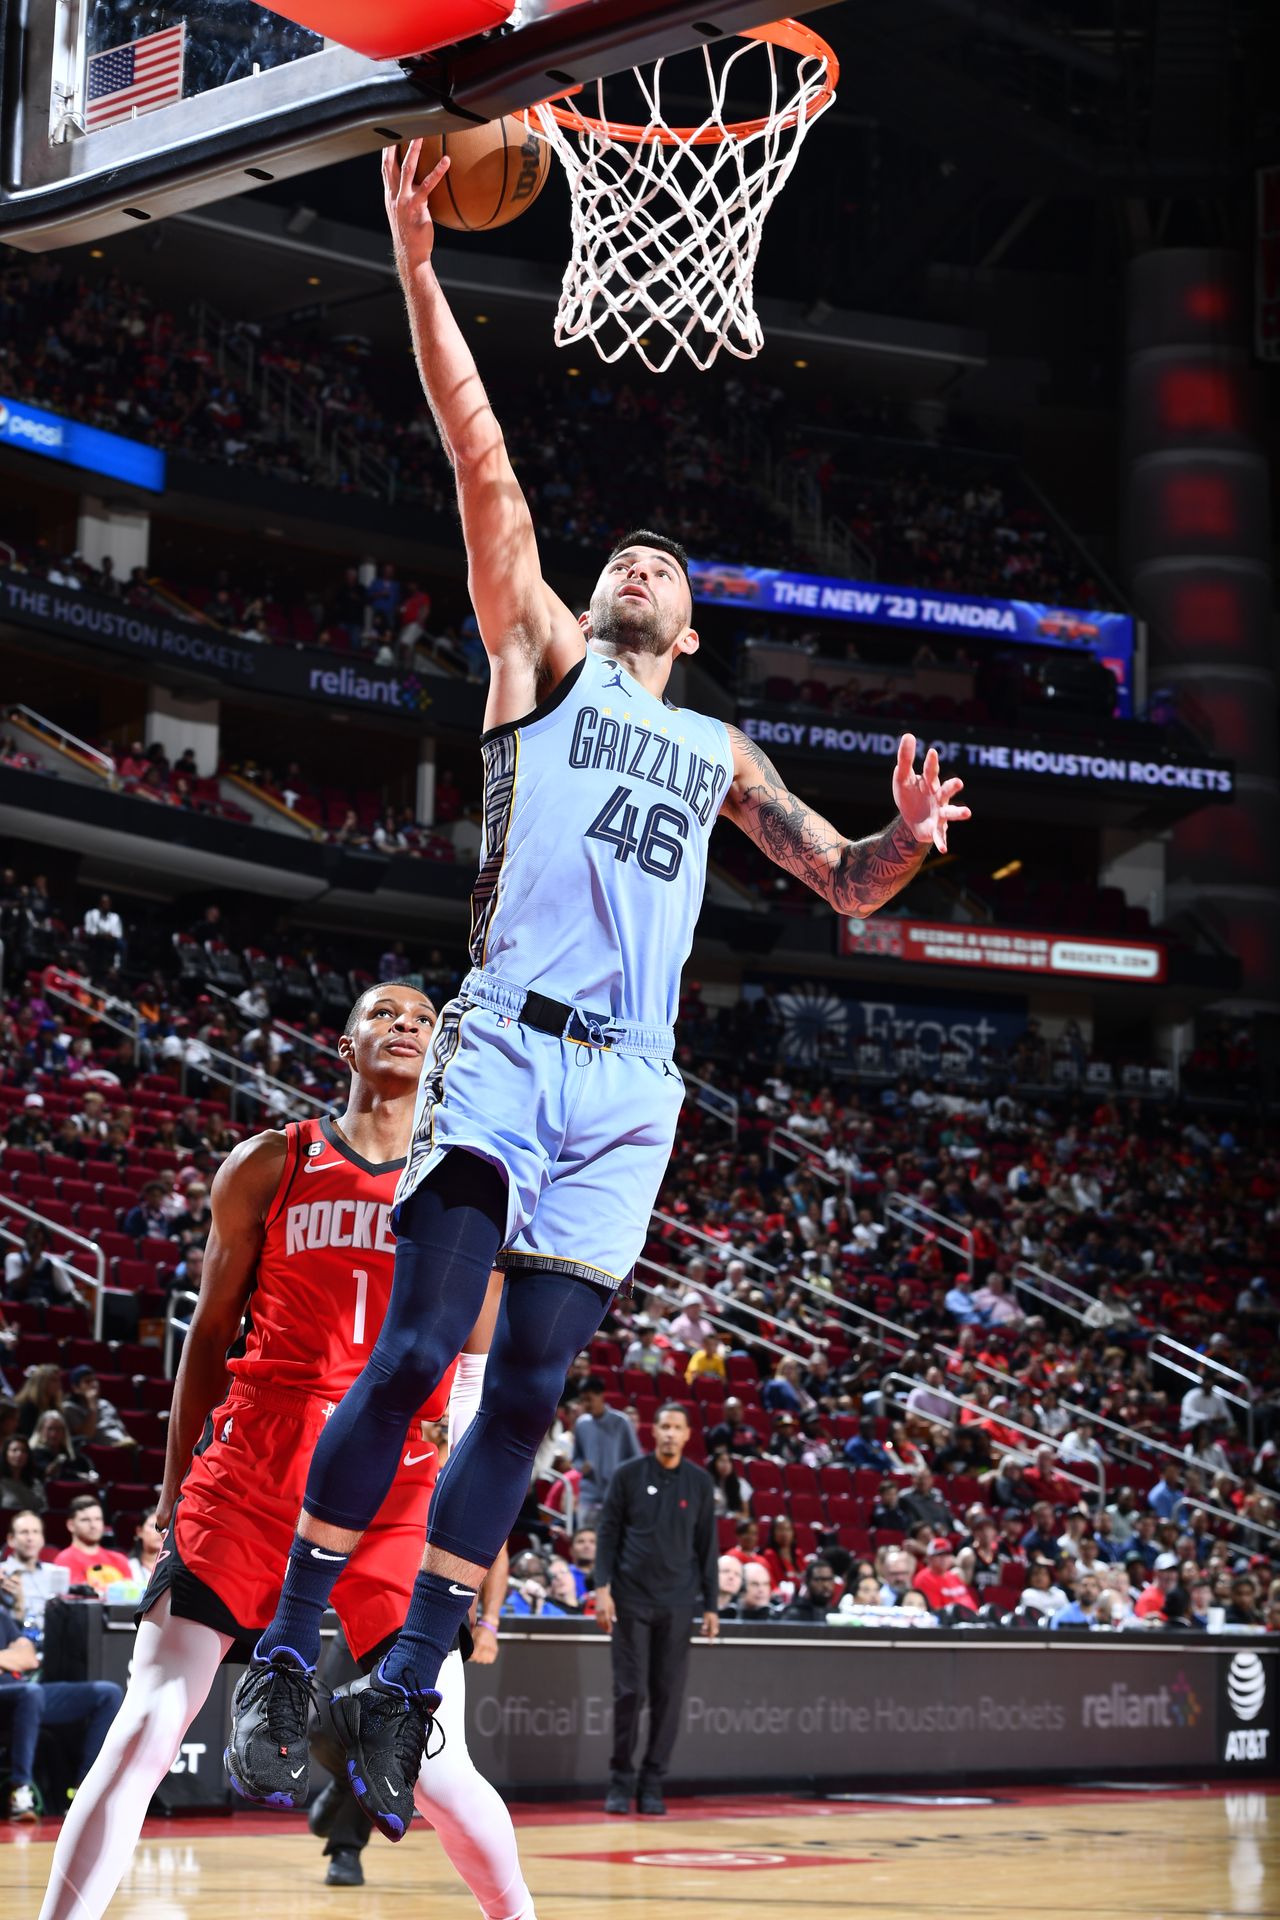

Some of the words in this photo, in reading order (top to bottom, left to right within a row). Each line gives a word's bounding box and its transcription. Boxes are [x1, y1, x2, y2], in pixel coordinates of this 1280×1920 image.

[8, 415, 63, 446] pepsi
[6, 584, 49, 617] THE
[54, 598, 158, 648] HOUSTON
[162, 630, 256, 673] ROCKETS
[773, 581, 818, 608] THE
[821, 587, 880, 615] NEW
[884, 595, 917, 619] '23
[921, 600, 1017, 633] TUNDRA
[310, 667, 402, 706] reliant
[568, 706, 727, 827] GRIZZLIES
[745, 718, 806, 745] ERGY
[809, 725, 926, 759] PROVIDR
[929, 738, 961, 762] OF
[965, 743, 1009, 769] THE
[1013, 748, 1126, 780] HOUSTON
[1129, 760, 1232, 792] ROCKETS
[584, 785, 690, 882] 46
[859, 1001, 998, 1062] Frost
[308, 1142, 322, 1157] 6
[286, 1200, 397, 1257] ROCKE
[352, 1269, 368, 1344] 1
[475, 1695, 578, 1737] Official
[686, 1696, 795, 1734] Provider
[798, 1695, 827, 1734] of
[830, 1697, 871, 1733] the
[874, 1697, 975, 1733] Houston
[979, 1695, 1066, 1731] Rockets
[1082, 1682, 1172, 1728] reliant
[1225, 1729, 1271, 1762] AT&T
